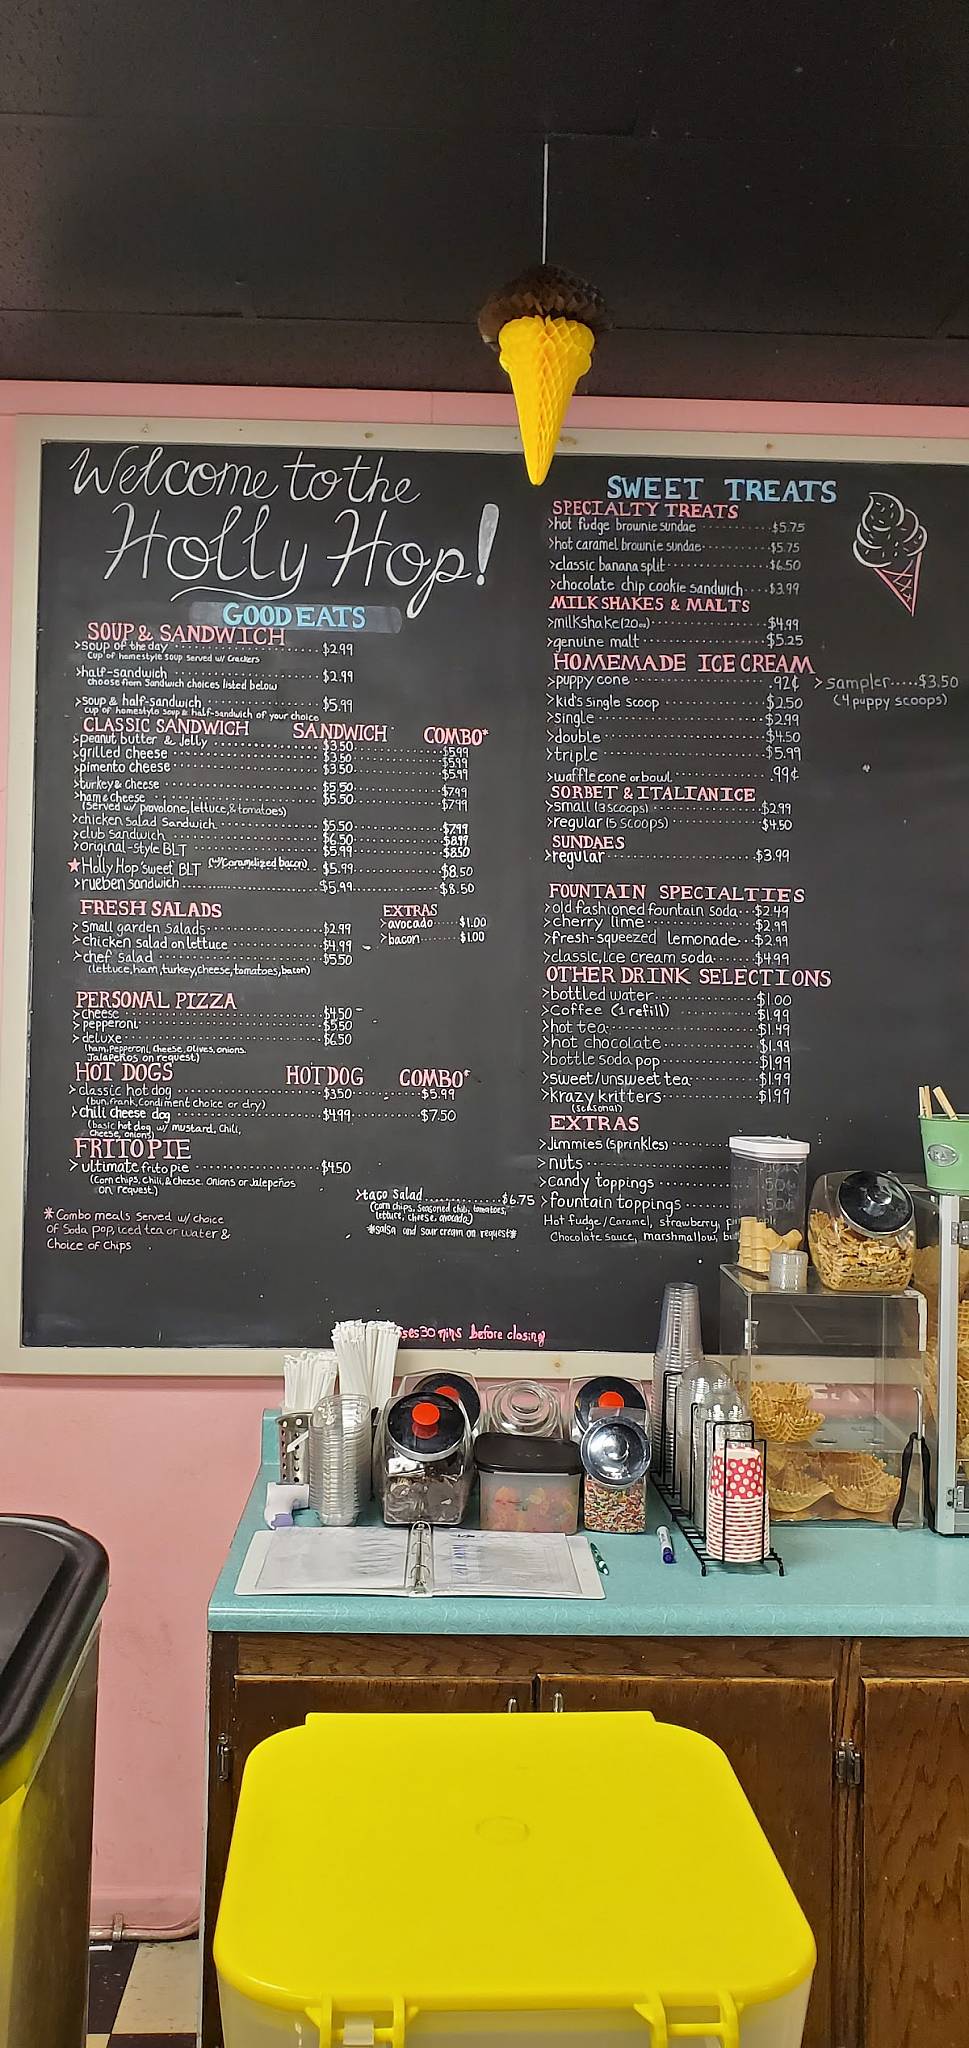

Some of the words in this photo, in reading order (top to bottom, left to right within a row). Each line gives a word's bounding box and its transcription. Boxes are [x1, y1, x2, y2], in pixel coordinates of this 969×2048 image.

[69, 444, 279, 498] Welcome
[283, 451, 342, 500] to
[343, 455, 420, 503] the
[607, 475, 704, 499] SWEET
[724, 479, 836, 503] TREATS
[553, 501, 659, 517] SPECIALTY
[665, 504, 738, 519] TREATS
[554, 517, 571, 529] hot
[579, 518, 609, 535] fudge
[616, 518, 657, 531] brownie
[772, 522, 805, 533] $5.75
[553, 537, 573, 550] hot
[576, 537, 618, 550] caramel
[622, 539, 663, 551] brownie
[771, 542, 799, 553] $5.75
[104, 503, 307, 601] Holly
[326, 504, 499, 619] Hop!
[556, 555, 595, 571] classic
[599, 558, 639, 571] banana
[641, 557, 665, 575] split
[770, 559, 801, 570] $6.50
[555, 575, 615, 591] chocolate
[621, 577, 645, 595] chip
[649, 578, 686, 592] cookie
[690, 579, 743, 596] sandwich
[770, 583, 799, 594] $3.99
[671, 599, 680, 610] &
[686, 598, 750, 612] MALTS
[222, 602, 291, 627] GOOD
[296, 606, 366, 628] EATS
[88, 622, 134, 641] SOUP
[139, 625, 153, 641] &
[160, 624, 286, 646] SANDWICH
[767, 633, 803, 648] $5.25
[323, 643, 352, 656] $2.99
[554, 637, 604, 653] genuine
[610, 634, 639, 648] malt
[554, 653, 686, 671] HOMEMADE
[698, 654, 735, 672] ICE
[741, 655, 815, 674] CREAM
[323, 669, 352, 683] $2.99
[557, 675, 594, 690] puppy
[597, 676, 630, 685] cone
[826, 673, 890, 693] sampler
[919, 674, 958, 688] $3.50
[223, 679, 246, 689] listed
[250, 680, 277, 690] below
[556, 693, 583, 707] kid's
[586, 694, 620, 710] single
[626, 698, 659, 712] scoop
[767, 694, 803, 711] $2.50
[853, 698, 890, 710] puppy
[84, 717, 150, 733] CLASSIC
[156, 719, 249, 736] SANDWICH
[554, 711, 594, 727] single
[765, 713, 798, 727] $2.99
[293, 723, 387, 743] SANDWICH
[555, 729, 601, 743] double
[766, 730, 800, 743] $4.50
[80, 746, 120, 761] grilled
[324, 751, 351, 763] $3.50
[554, 748, 597, 765] triple
[766, 746, 801, 761] $5.99
[80, 762, 125, 774] pimento
[129, 762, 170, 773] cheese
[323, 764, 353, 775] $3.50
[551, 786, 618, 799] SORBET
[624, 787, 633, 799] &
[78, 814, 123, 827] chicken
[323, 818, 353, 831] $5.50
[554, 816, 603, 831] regular
[762, 818, 792, 831] $4.50
[553, 835, 624, 849] SUNDAES
[553, 850, 605, 870] regular
[756, 849, 789, 863] $3.99
[82, 857, 113, 877] Holly
[116, 858, 137, 876] Hop
[440, 863, 473, 880] $8.50
[82, 878, 125, 890] rueben
[127, 876, 179, 889] sandwich
[320, 880, 354, 894] $5.99
[440, 882, 474, 896] $8.50
[549, 884, 646, 899] FOUNTAIN
[660, 885, 804, 902] SPECIALTIES
[80, 900, 147, 915] FRESH
[151, 901, 222, 918] SALADS
[384, 904, 437, 917] EXTRAS
[553, 902, 571, 915] old
[576, 900, 644, 916] fashioned
[648, 903, 704, 916] fountain
[709, 905, 738, 917] soda
[754, 905, 788, 918] $2.49
[117, 921, 160, 936] garden
[324, 922, 351, 936] $2.99
[388, 917, 433, 929] avocado
[460, 916, 486, 927] $1.00
[553, 916, 603, 931] cherry
[612, 915, 644, 928] lime
[754, 919, 787, 932] $2.99
[83, 935, 131, 948] chicken
[171, 941, 184, 949] on
[187, 937, 227, 949] lettuce
[389, 933, 420, 945] bacon
[460, 931, 484, 943] $1.00
[668, 931, 739, 946] lemonade
[547, 966, 615, 982] OTHER
[621, 967, 691, 984] DRINK
[700, 969, 831, 987] SELECTIONS
[76, 991, 170, 1008] PERSONAL
[175, 993, 237, 1009] PIZZA
[551, 985, 605, 1000] bottled
[610, 988, 654, 1001] water
[757, 991, 791, 1008] $1.00
[82, 1016, 138, 1032] pepperoni
[551, 1020, 573, 1033] hot
[577, 1022, 607, 1034] tea
[82, 1033, 122, 1043] deluxe
[552, 1035, 577, 1048] hot
[584, 1035, 661, 1049] chocolate
[551, 1052, 595, 1065] bottle
[599, 1054, 632, 1065] soda
[636, 1057, 660, 1071] pop
[75, 1062, 115, 1081] HOT
[121, 1062, 173, 1081] DOGS
[664, 1073, 691, 1086] tea
[79, 1084, 121, 1096] classic
[127, 1084, 148, 1096] hot
[152, 1084, 171, 1100] dog
[422, 1088, 454, 1100] $5.99
[599, 1089, 661, 1105] kritters
[152, 1108, 170, 1124] dog
[421, 1109, 456, 1122] $7.50
[550, 1115, 639, 1131] EXTRAS
[74, 1137, 143, 1158] FRITO
[148, 1138, 191, 1159] PIE
[82, 1159, 139, 1173] ultimate
[170, 1164, 189, 1177] pie
[550, 1155, 583, 1169] nuts
[548, 1174, 589, 1195] candy
[595, 1172, 654, 1194] toppings
[362, 1189, 387, 1200] taco
[502, 1192, 535, 1206] $6.75
[550, 1194, 612, 1208] fountain
[617, 1196, 681, 1218] toppings
[95, 1210, 130, 1221] meals
[118, 1225, 141, 1235] iced
[144, 1225, 164, 1234] tea
[182, 1229, 218, 1238] water
[469, 1324, 502, 1339] before
[507, 1324, 545, 1347] closing
